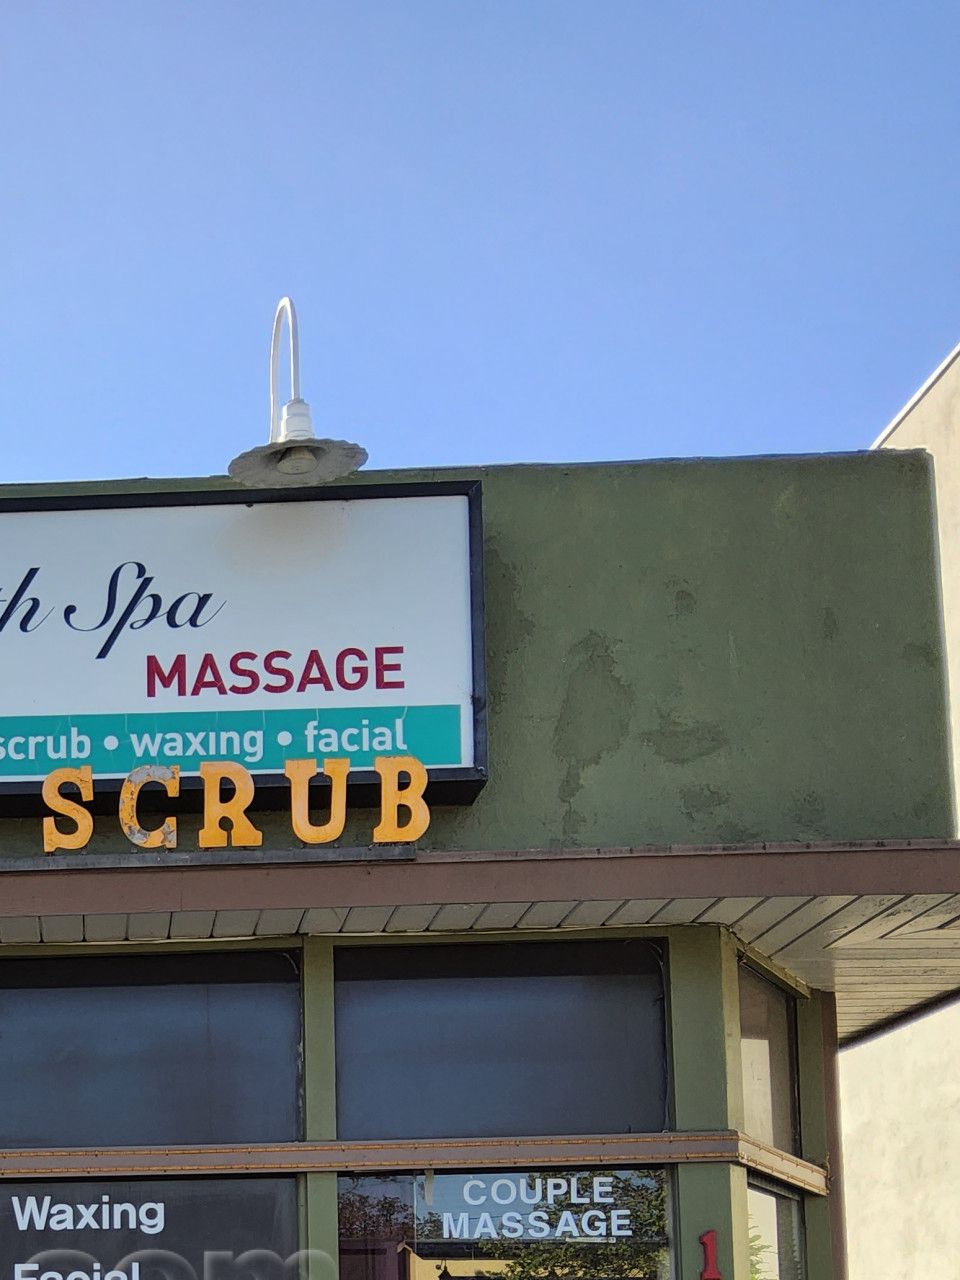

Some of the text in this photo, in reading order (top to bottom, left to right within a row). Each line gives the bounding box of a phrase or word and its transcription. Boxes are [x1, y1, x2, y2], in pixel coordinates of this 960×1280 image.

[65, 561, 224, 659] Spa
[146, 646, 405, 698] MASSAGE
[130, 725, 264, 765] waxing
[305, 719, 408, 753] facial
[42, 756, 431, 854] SCRUB
[463, 1177, 614, 1205] COUPLE
[12, 1195, 165, 1234] Waxing
[442, 1210, 632, 1238] MASSAGE
